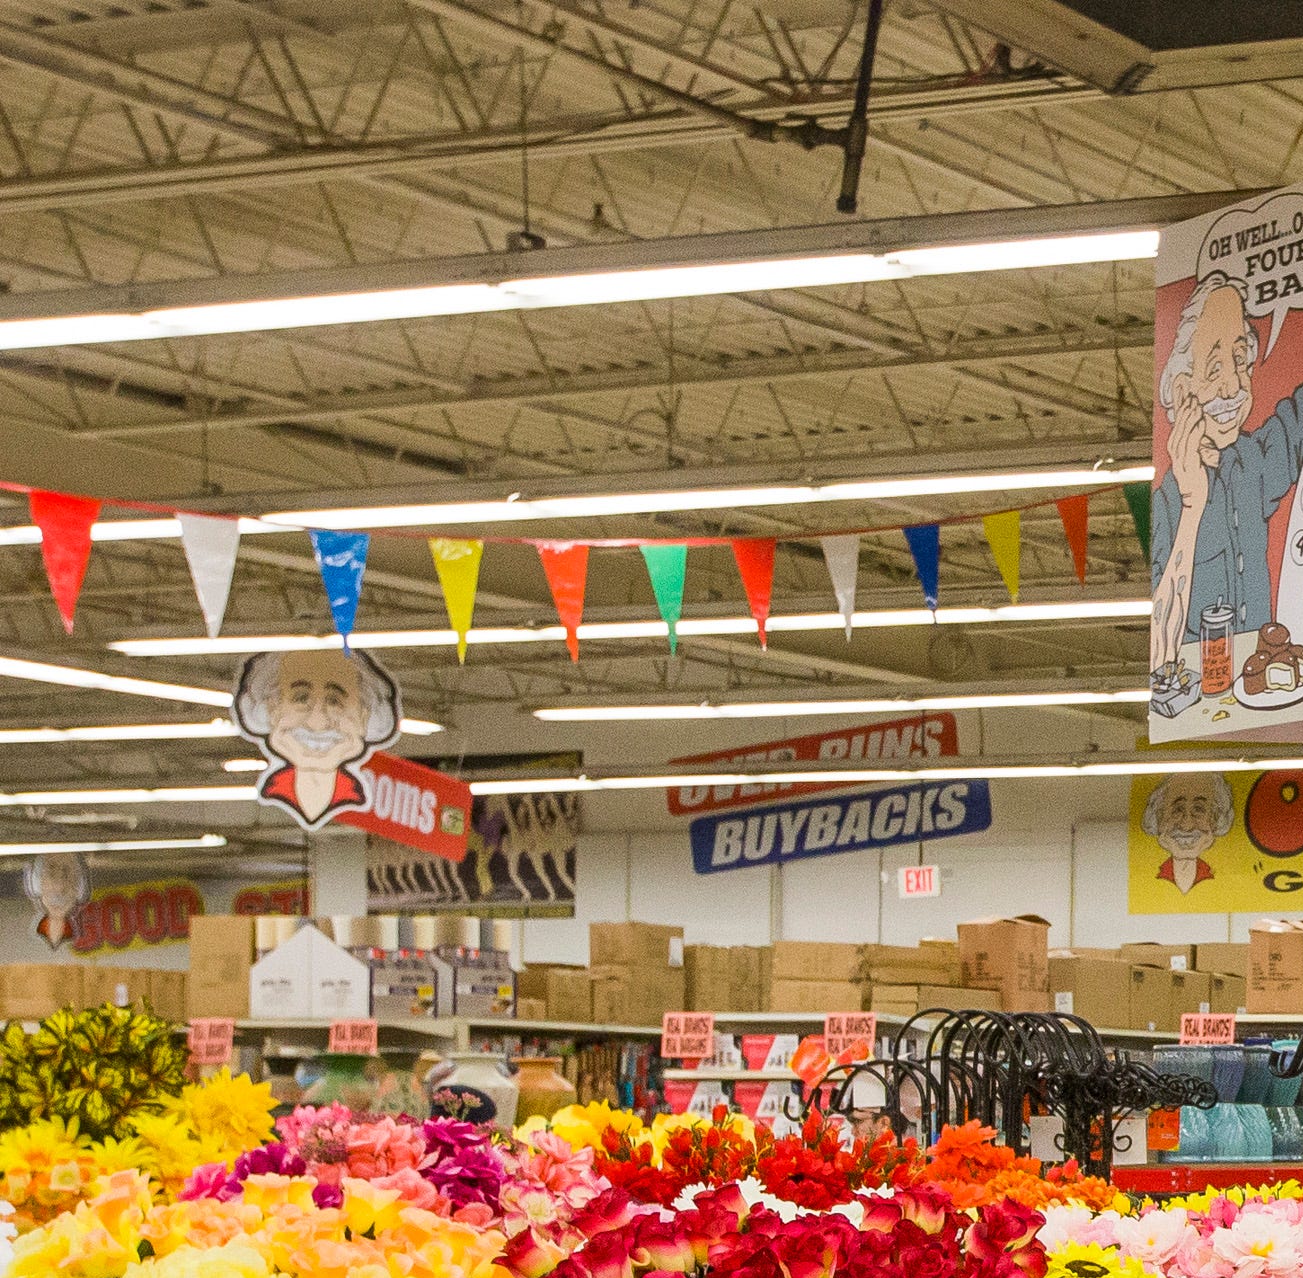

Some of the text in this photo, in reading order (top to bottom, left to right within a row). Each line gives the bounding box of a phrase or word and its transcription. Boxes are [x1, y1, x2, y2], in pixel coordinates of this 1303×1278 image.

[1209, 234, 1232, 261] OH
[711, 783, 970, 868] BUYBACKS
[905, 867, 934, 895] EXIT
